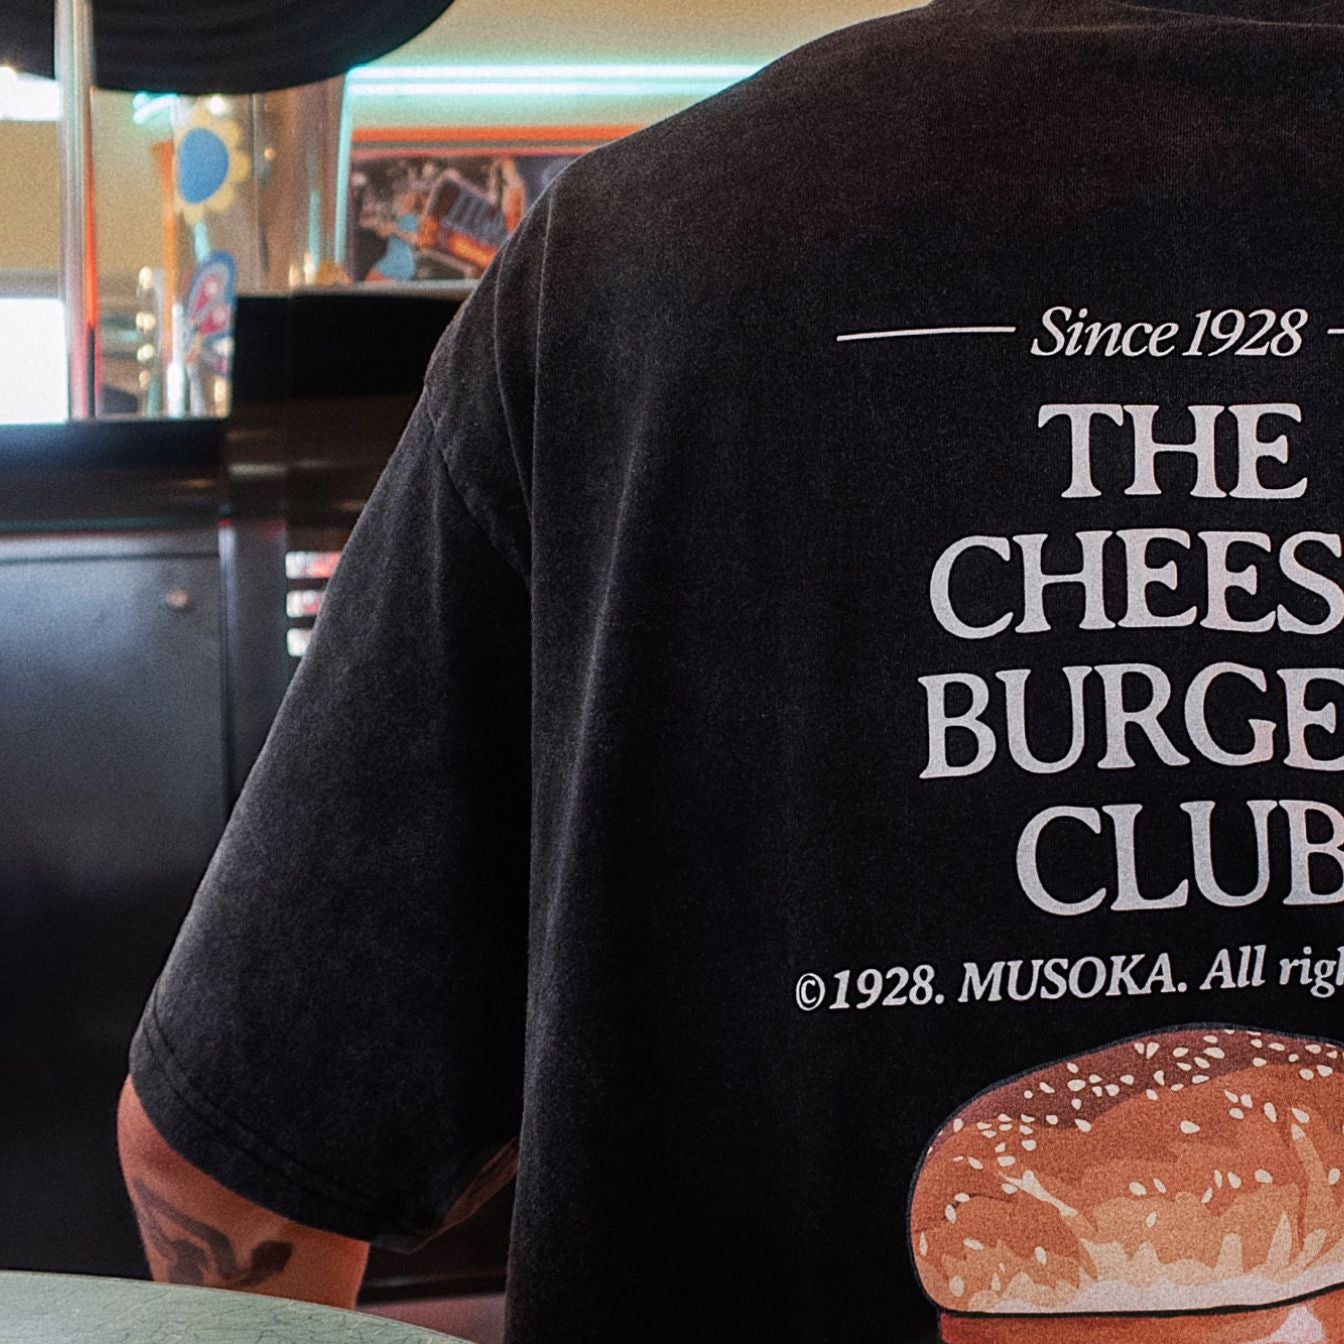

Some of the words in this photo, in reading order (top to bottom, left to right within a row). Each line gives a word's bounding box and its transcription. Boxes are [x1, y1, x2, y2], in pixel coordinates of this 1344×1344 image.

[1030, 306, 1179, 357] Since
[1182, 309, 1308, 356] 1928
[1038, 403, 1307, 500] THE
[958, 953, 1187, 1002] MUSOKA.
[1199, 945, 1266, 990] All
